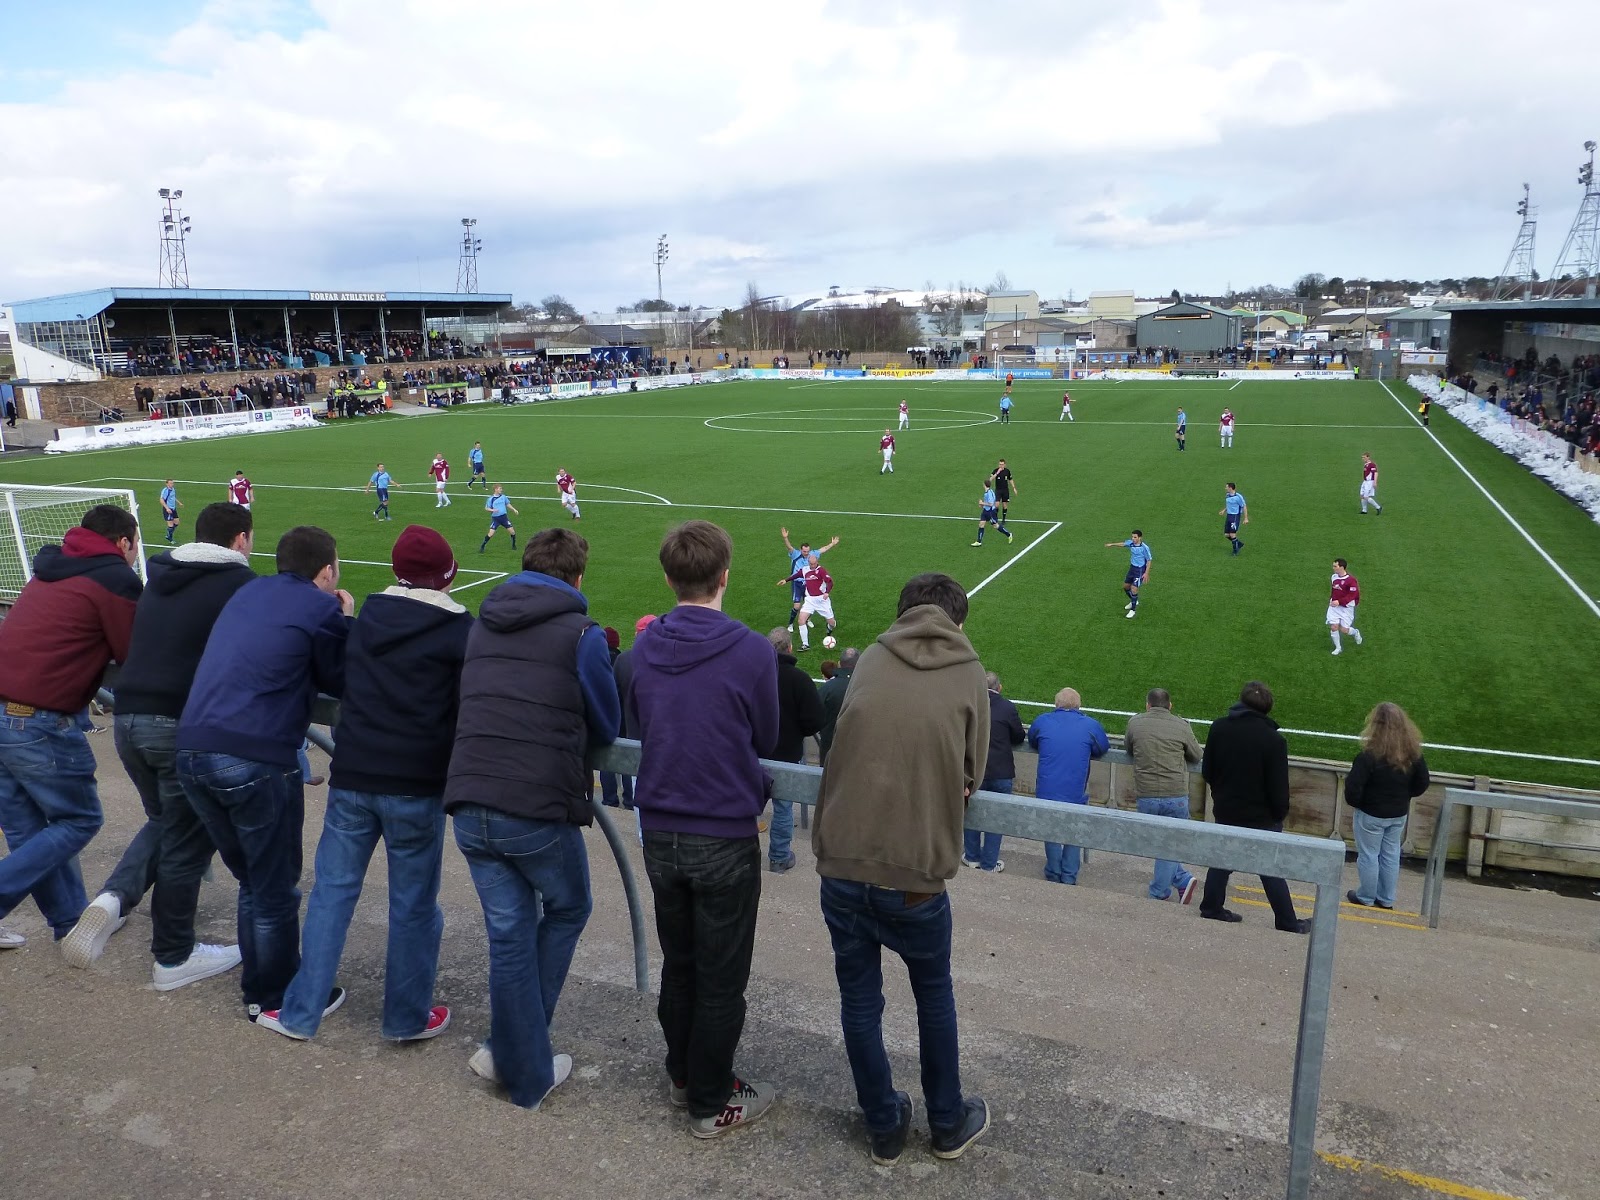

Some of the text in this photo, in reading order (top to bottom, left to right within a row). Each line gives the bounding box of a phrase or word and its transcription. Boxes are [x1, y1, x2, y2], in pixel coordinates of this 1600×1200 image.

[310, 292, 338, 301] FORFAR
[341, 293, 374, 301] ATHLETIC
[560, 383, 588, 393] SAMARITANS
